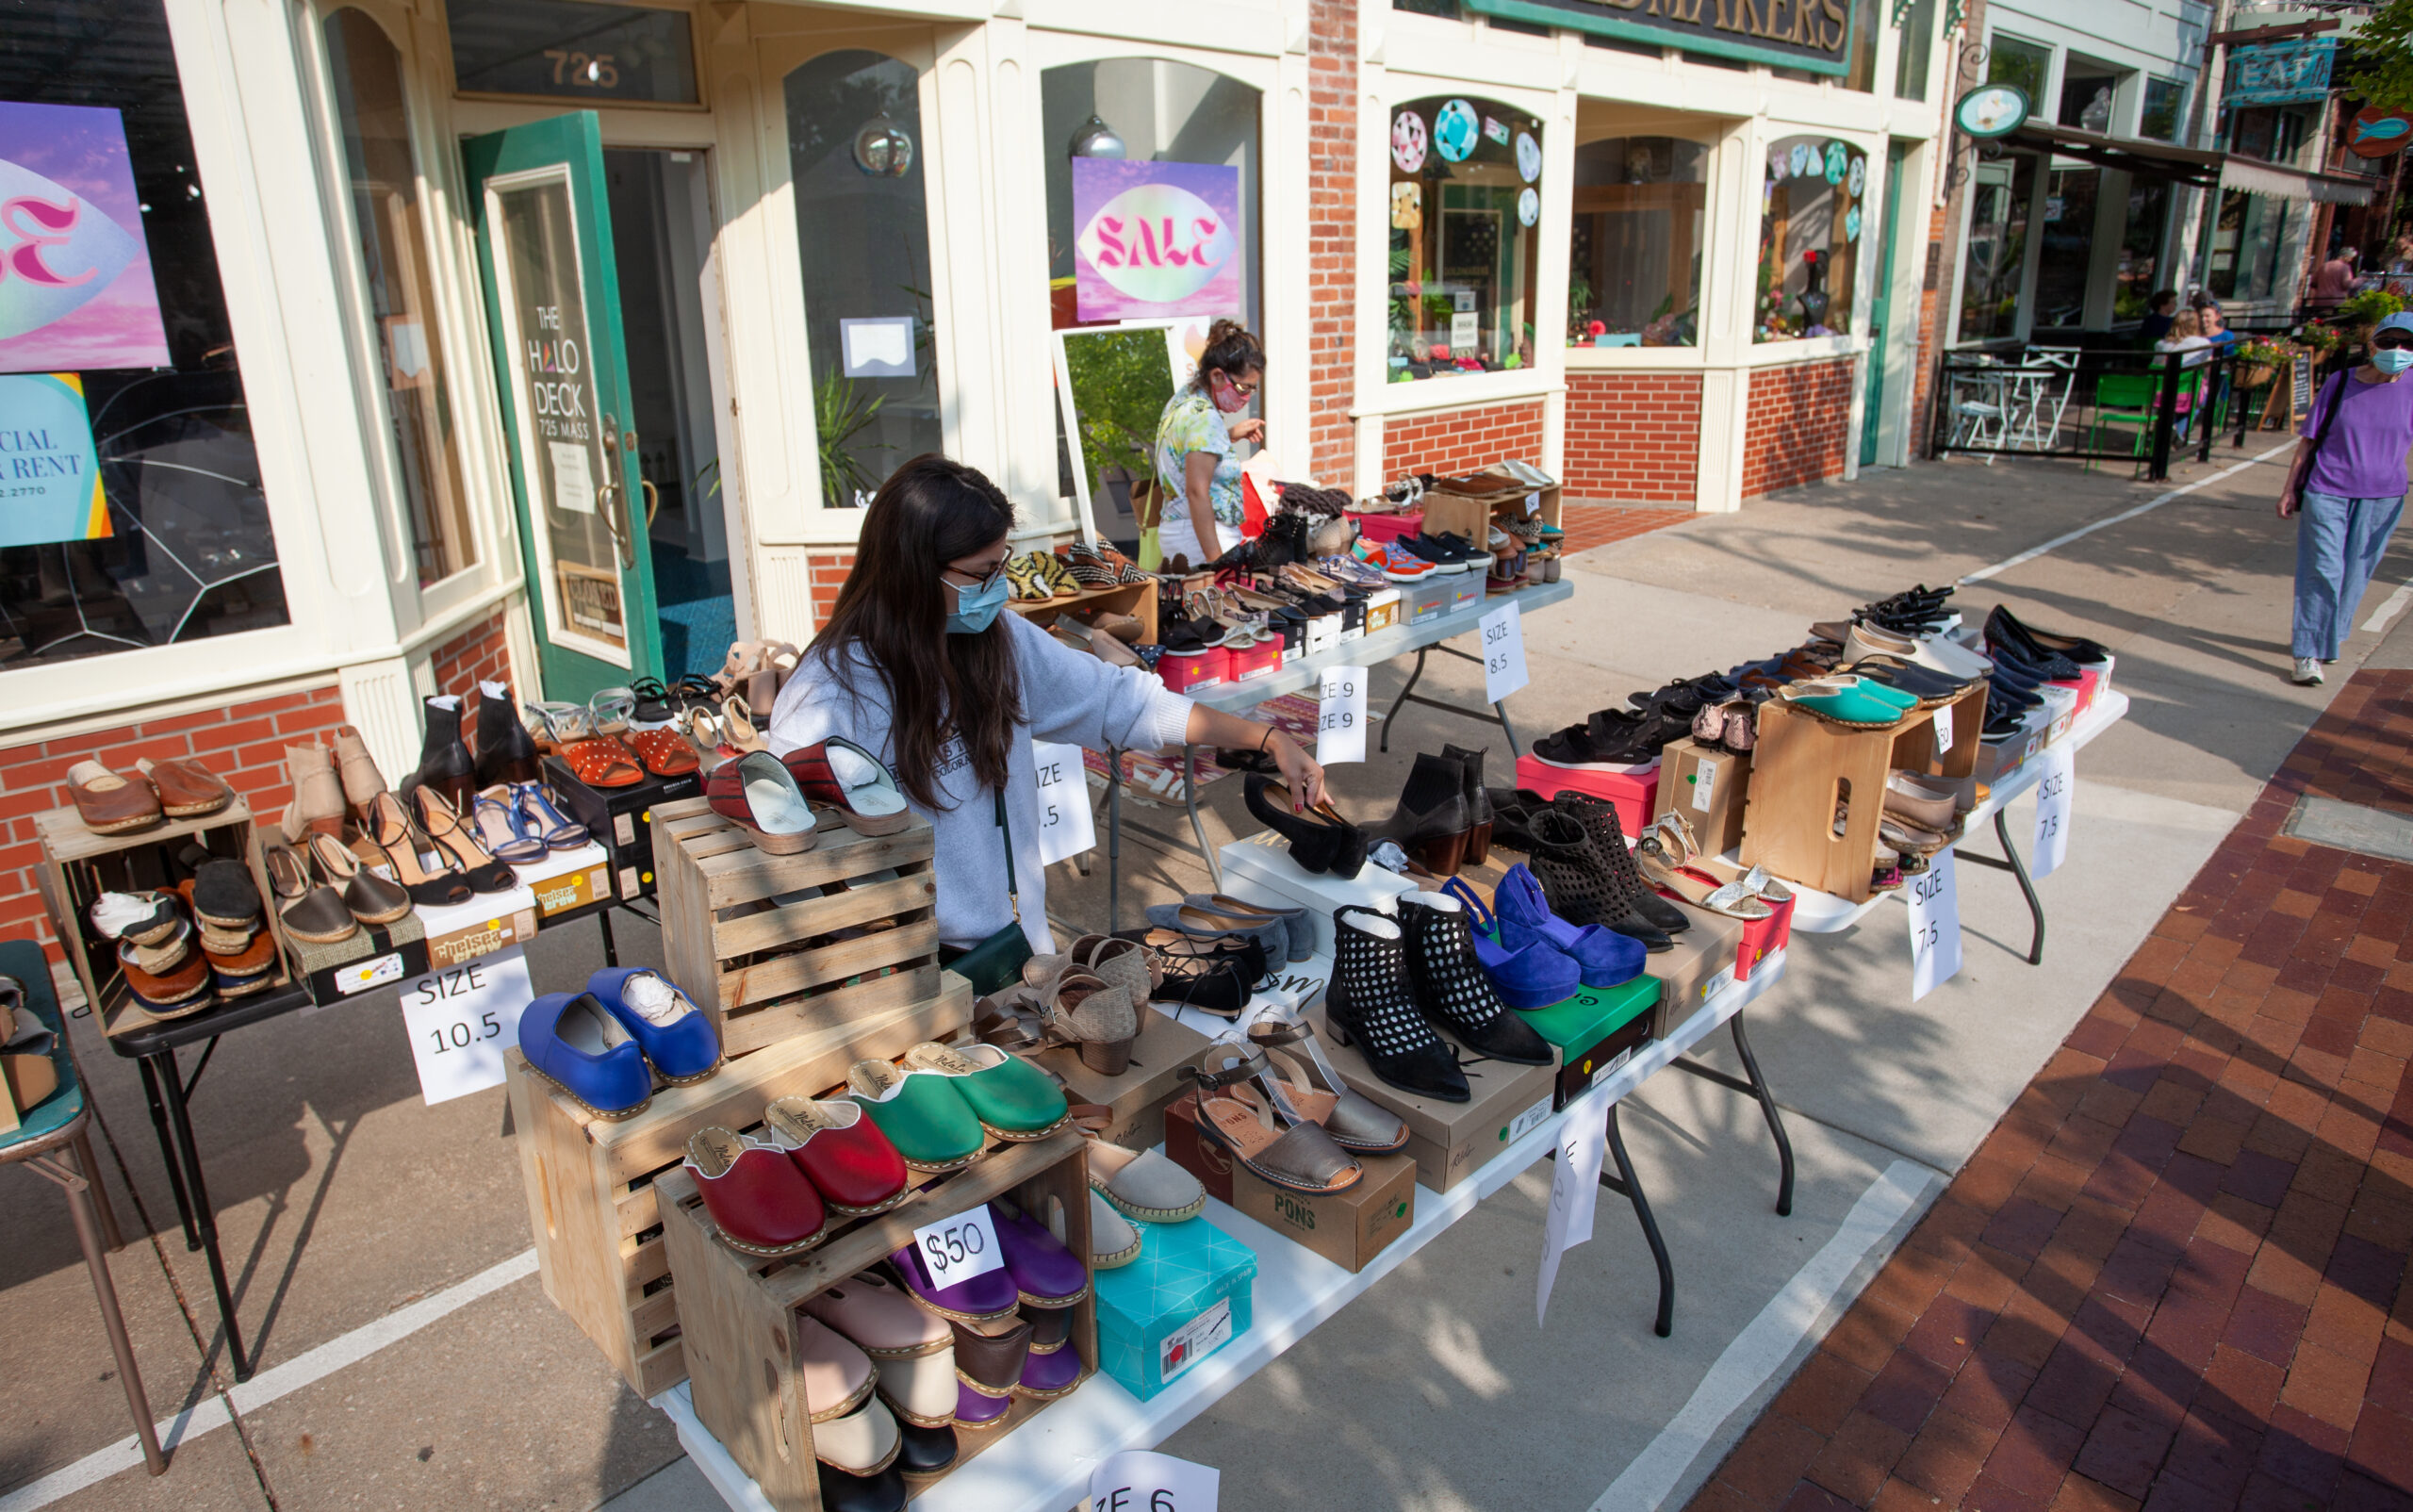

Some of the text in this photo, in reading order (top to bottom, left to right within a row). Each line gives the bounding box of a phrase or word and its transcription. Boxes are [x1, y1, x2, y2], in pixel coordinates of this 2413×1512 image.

[543, 49, 618, 89] 725
[2241, 58, 2311, 87] EAT
[1096, 213, 1222, 271] SALE
[536, 305, 561, 330] THE
[533, 381, 586, 418] DECK
[539, 419, 590, 439] 725 MASS
[12, 453, 81, 479] RENT
[1486, 620, 1509, 646] SIZE
[1490, 652, 1508, 675] 8.5
[1343, 682, 1354, 698] 9
[1342, 713, 1353, 728] 9
[2043, 772, 2063, 799] SIZE
[2041, 815, 2058, 841] 7.5
[1915, 868, 1943, 906] SIZE
[1918, 920, 1939, 953] 7.5
[417, 962, 487, 1005] SIZE
[430, 1011, 501, 1054] 10.5
[1274, 1193, 1315, 1230] PONS
[926, 1222, 985, 1274] $50
